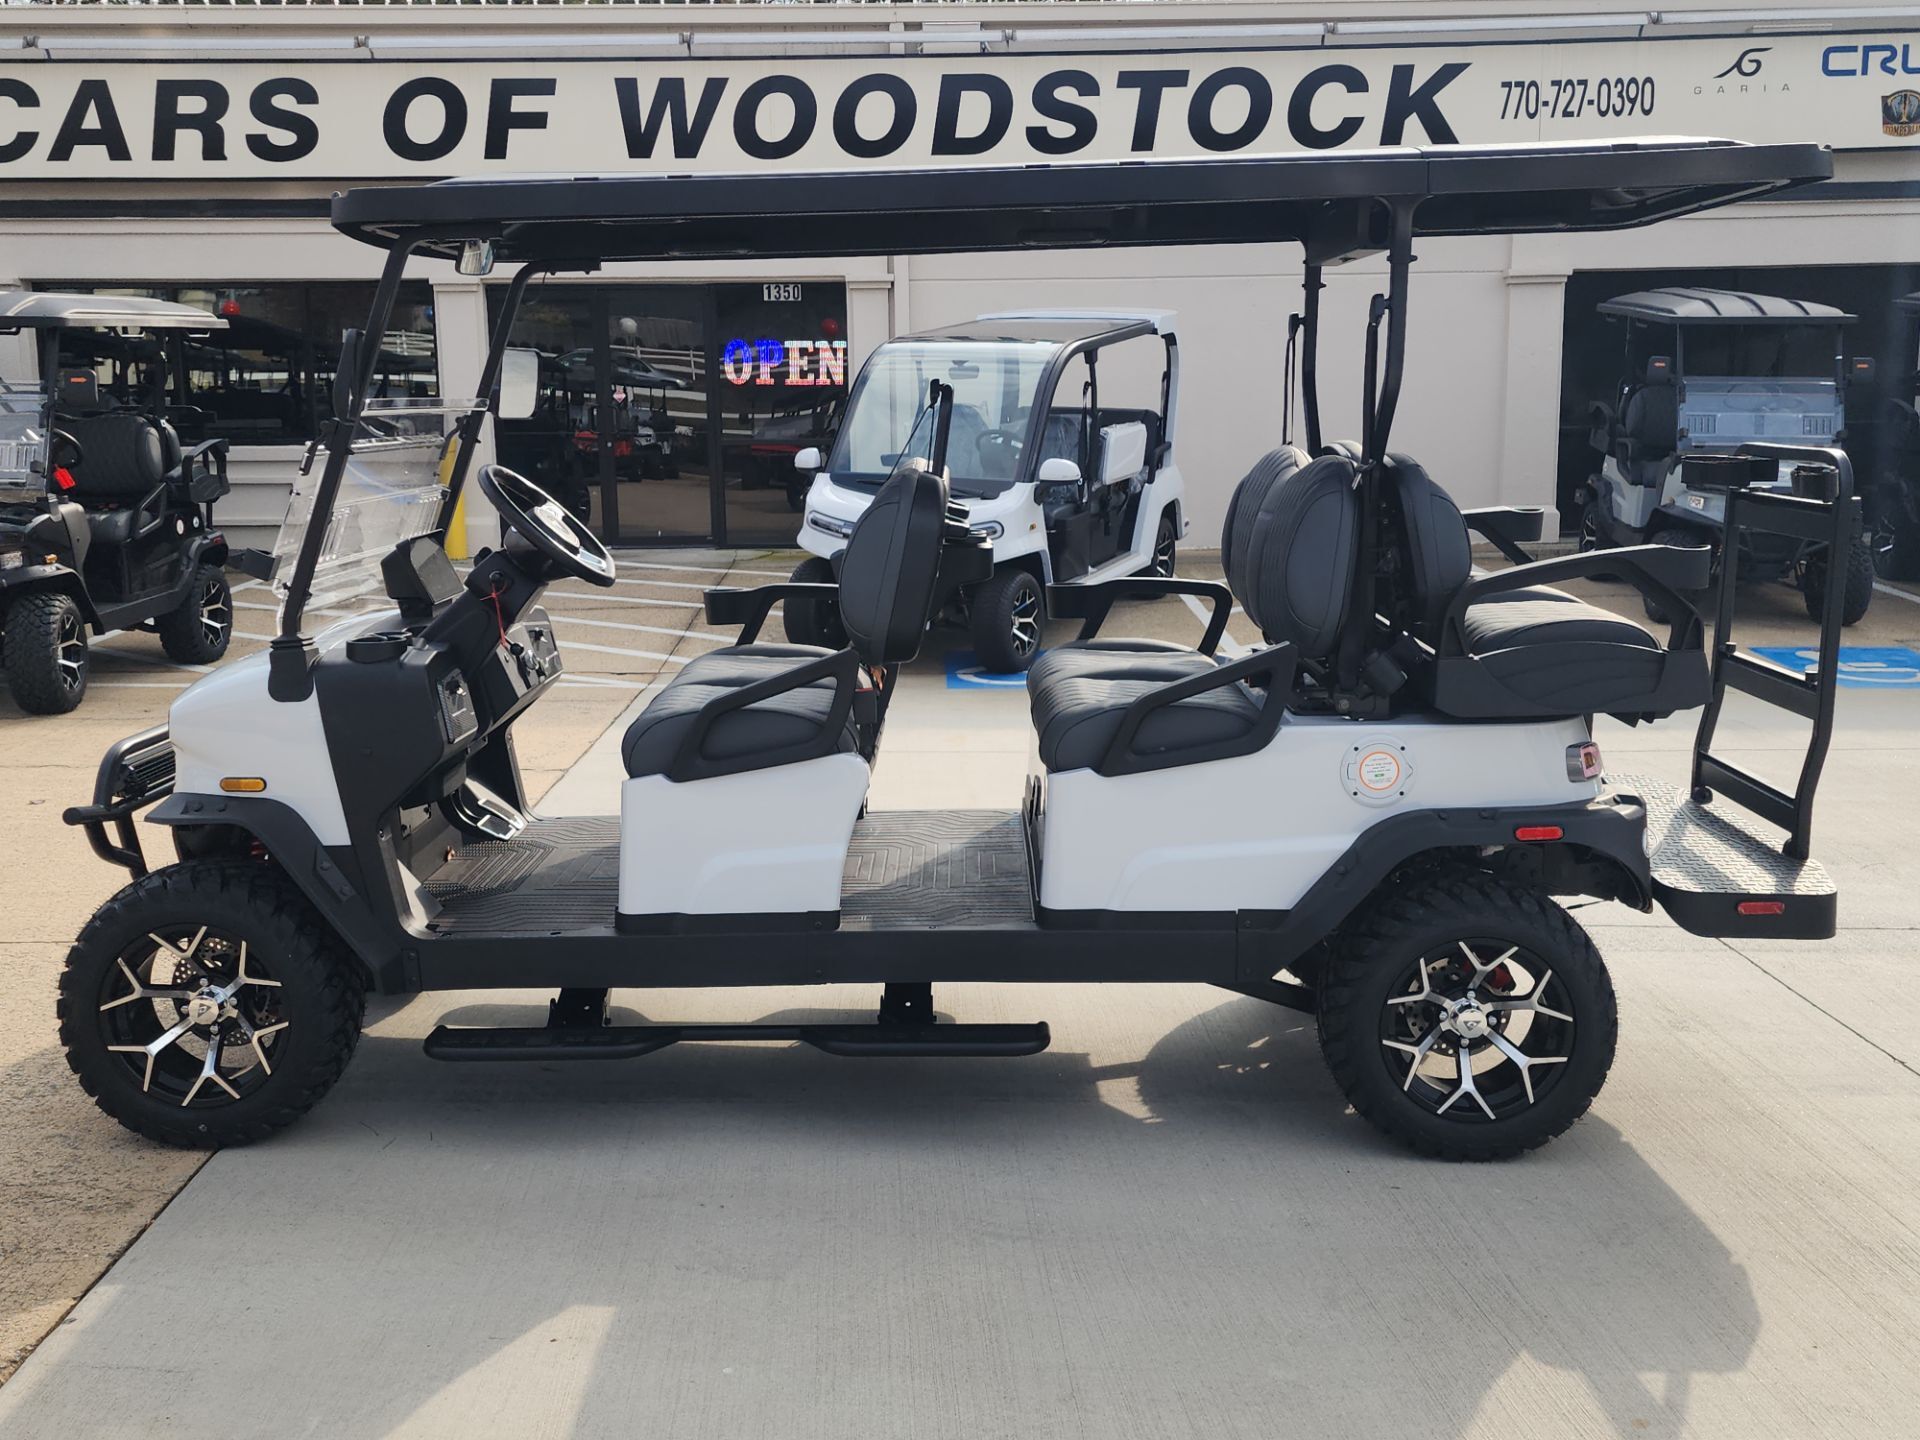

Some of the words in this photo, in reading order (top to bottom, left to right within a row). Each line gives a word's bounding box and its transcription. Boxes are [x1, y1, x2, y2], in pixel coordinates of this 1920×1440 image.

[1500, 76, 1655, 120] 770-727-0390
[1693, 83, 1790, 95] GARIA
[0, 78, 319, 163] CARS
[383, 77, 557, 162] OF
[614, 63, 1473, 160] WOODSTOCK
[764, 284, 800, 300] 1350
[724, 339, 847, 386] OPEN
